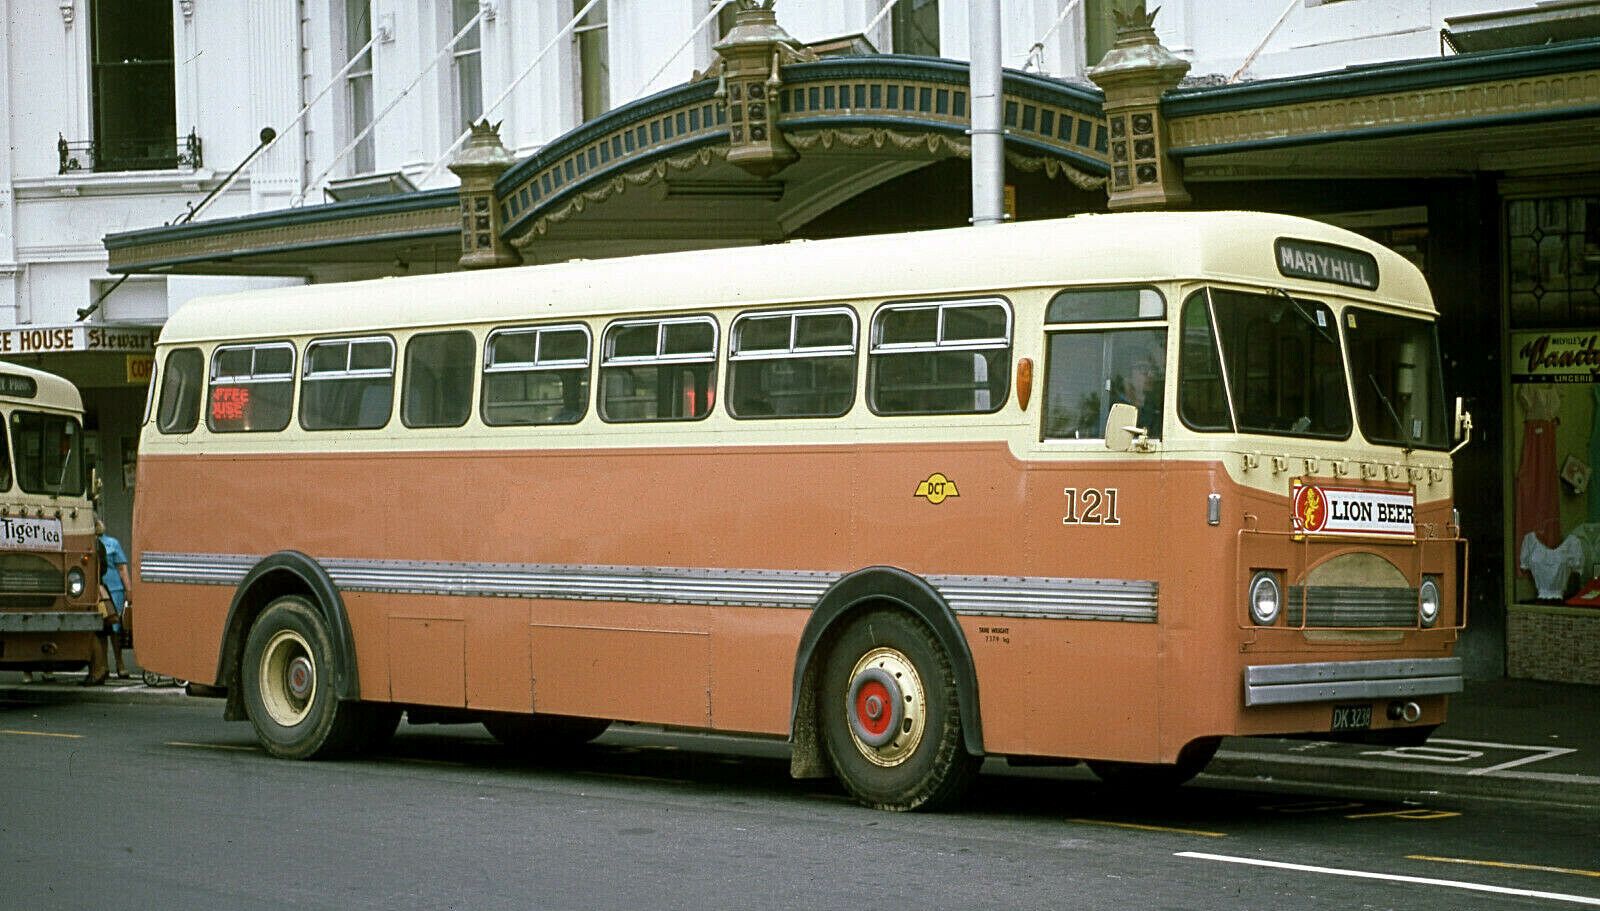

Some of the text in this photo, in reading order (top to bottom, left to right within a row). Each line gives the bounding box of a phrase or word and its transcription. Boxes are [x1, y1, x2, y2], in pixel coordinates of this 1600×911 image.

[1280, 246, 1372, 287] MARYHILL
[21, 328, 74, 351] HOUSE
[927, 482, 946, 497] DCT
[1062, 487, 1121, 525] 121
[1331, 499, 1415, 524] LION BEER
[0, 517, 60, 544] Tiger tea
